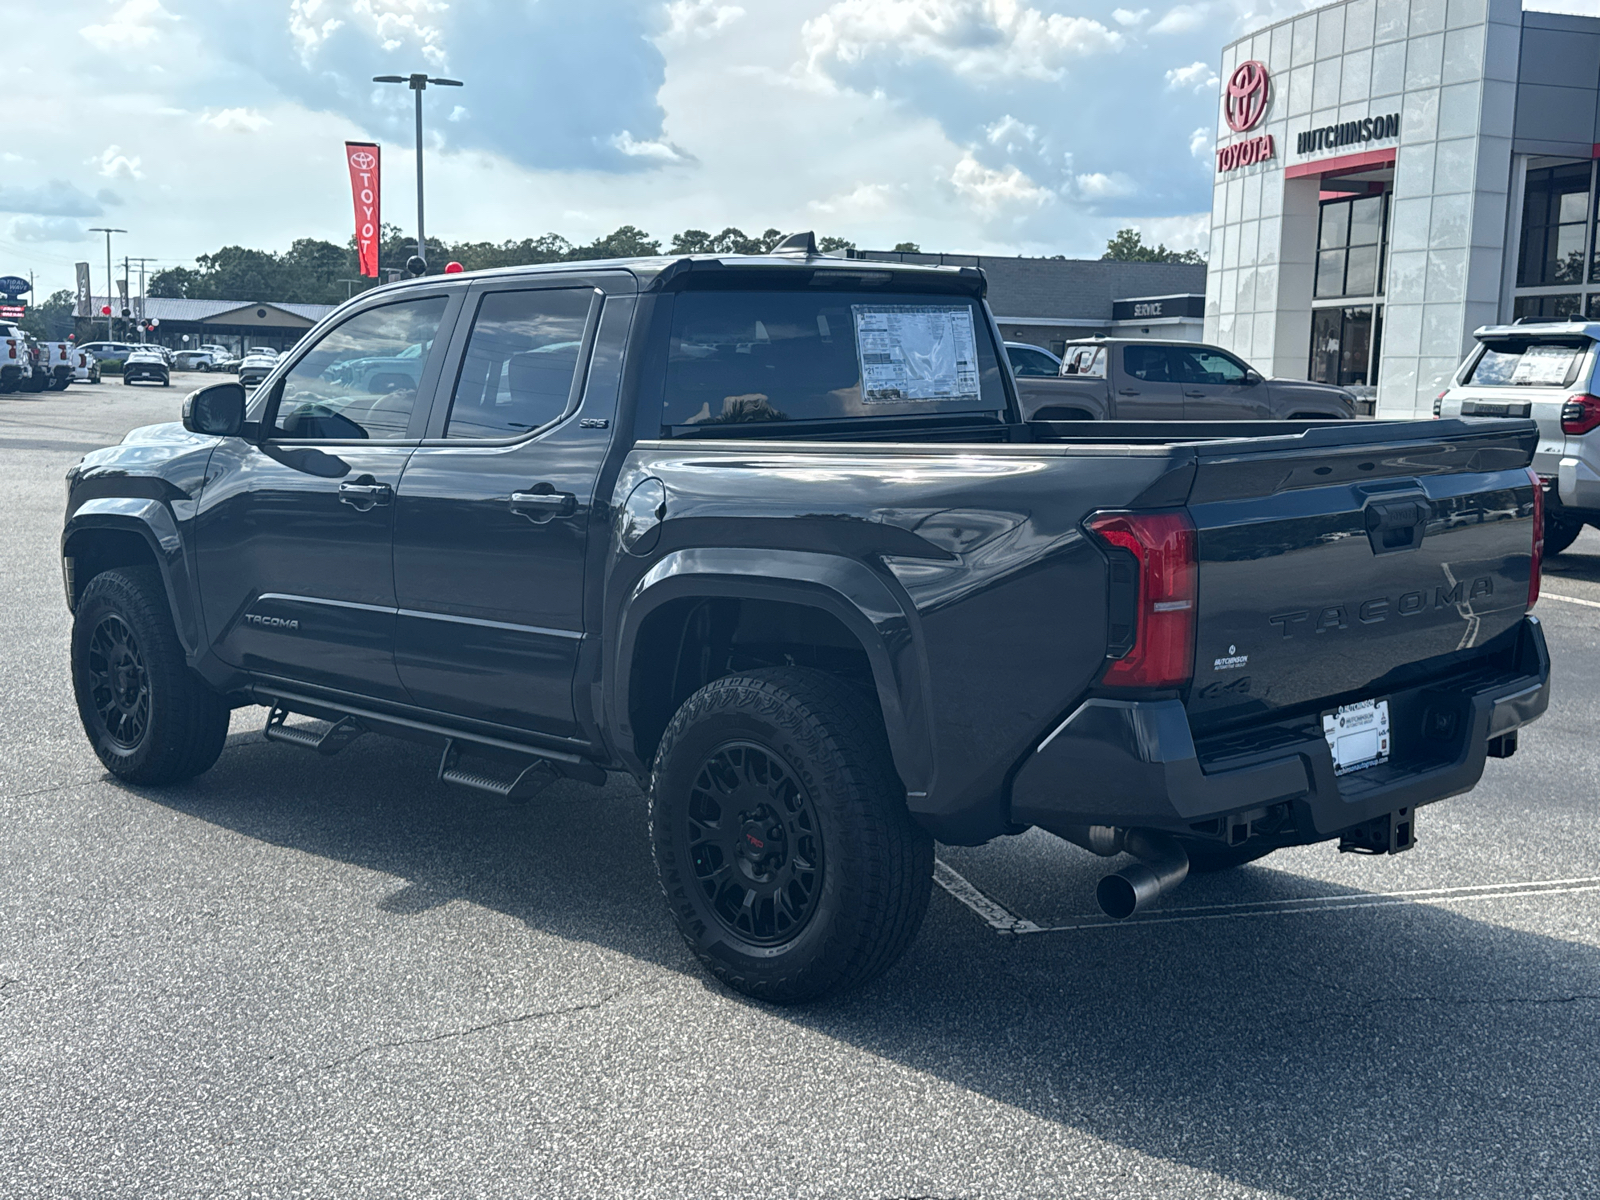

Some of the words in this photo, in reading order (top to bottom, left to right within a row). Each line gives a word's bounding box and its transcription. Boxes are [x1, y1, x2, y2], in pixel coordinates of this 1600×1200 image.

[1297, 113, 1399, 154] HUTCHINSON
[1216, 134, 1274, 173] TOYOTA
[360, 172, 374, 254] TOYOT
[1134, 303, 1162, 316] SERVICE
[579, 418, 609, 429] SR5
[1268, 575, 1494, 640] TACOMA
[245, 613, 299, 630] TACOMA
[1213, 655, 1248, 666] HUTCHINSON
[746, 833, 764, 848] TRD
